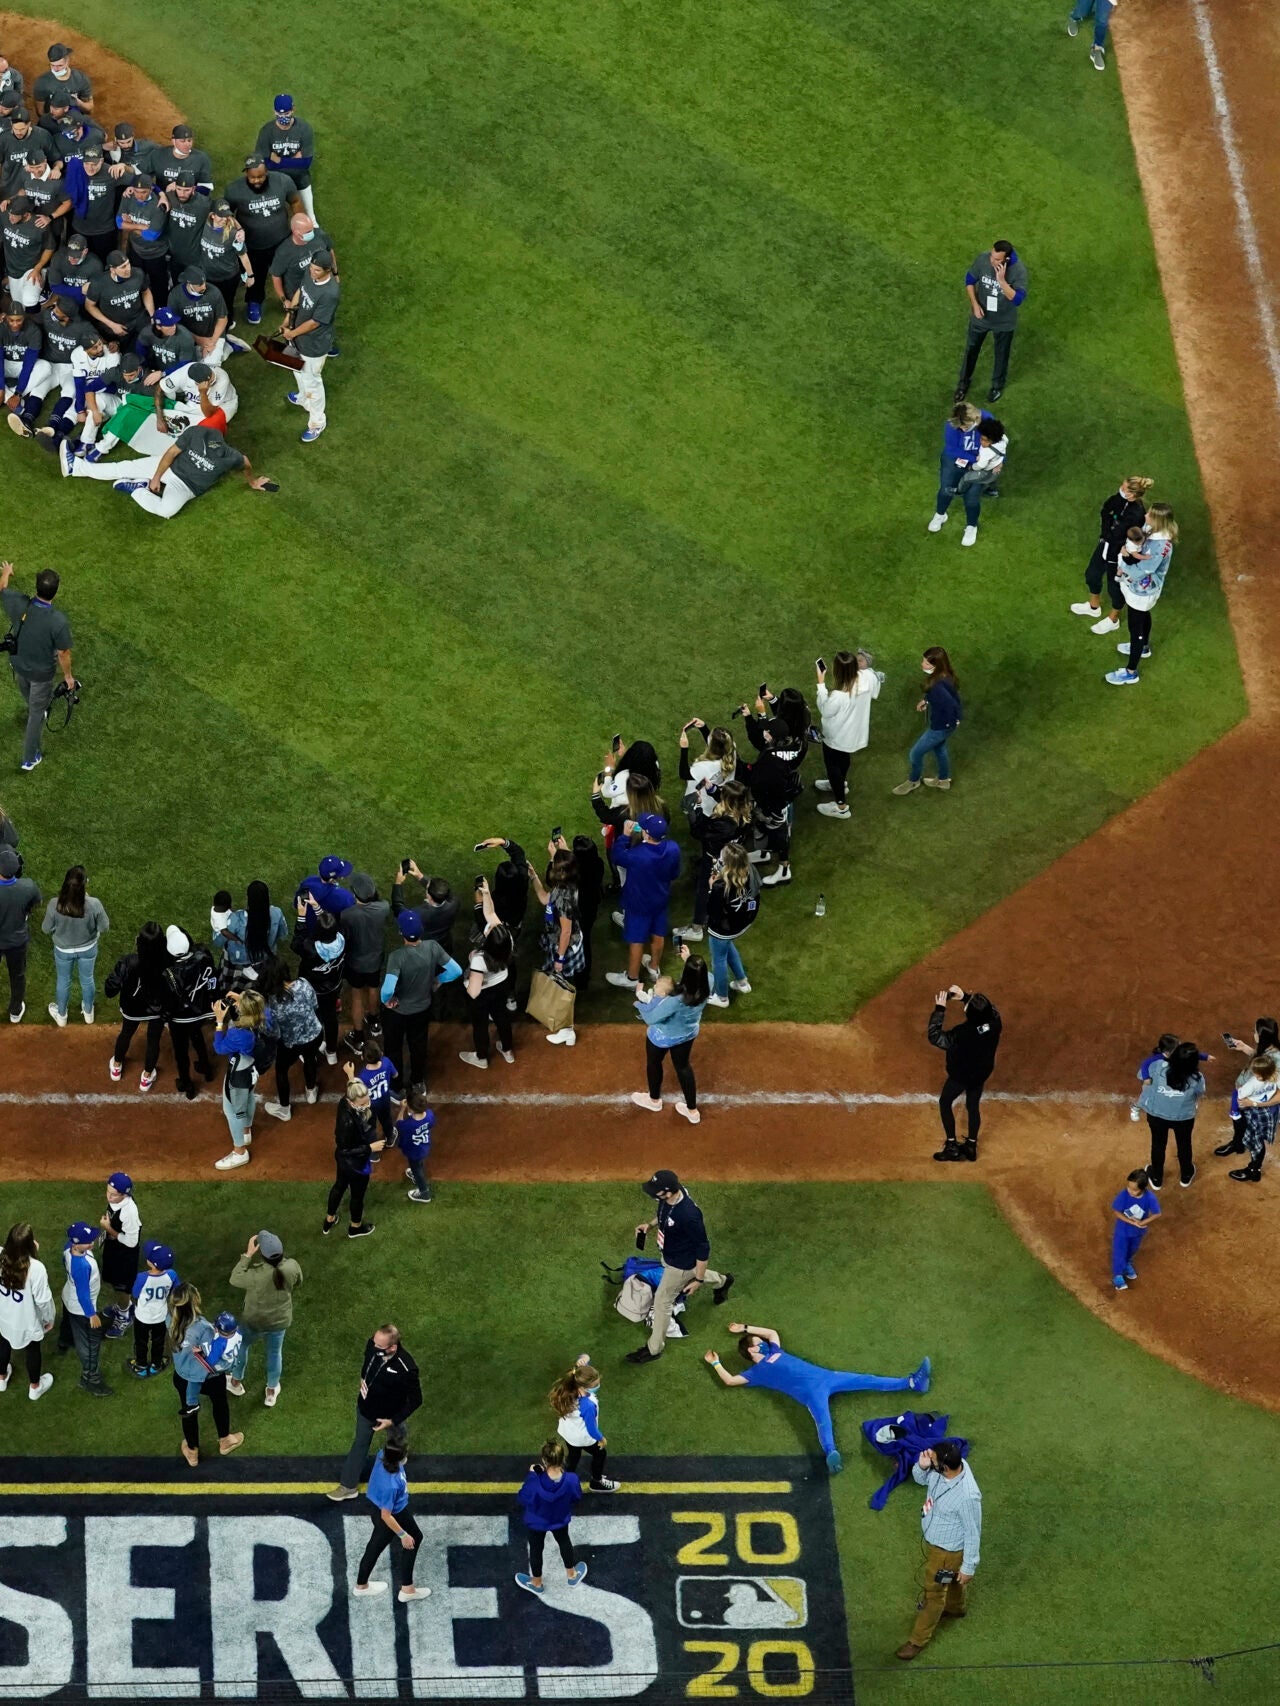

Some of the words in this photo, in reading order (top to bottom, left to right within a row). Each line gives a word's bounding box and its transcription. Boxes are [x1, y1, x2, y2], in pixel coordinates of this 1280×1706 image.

[249, 199, 280, 210] CHAMPIONS
[170, 210, 196, 223] CHAMPIONS
[4, 228, 30, 245] CHAMPIONS
[201, 238, 225, 254] CHAMPIONS
[111, 291, 139, 305] CHAMPIONS
[184, 305, 212, 315] CHAMPIONS
[49, 333, 76, 346] CHAMPIONS
[369, 1071, 386, 1085] BETTS
[671, 1511, 800, 1565] 20
[682, 1640, 815, 1697] 20
